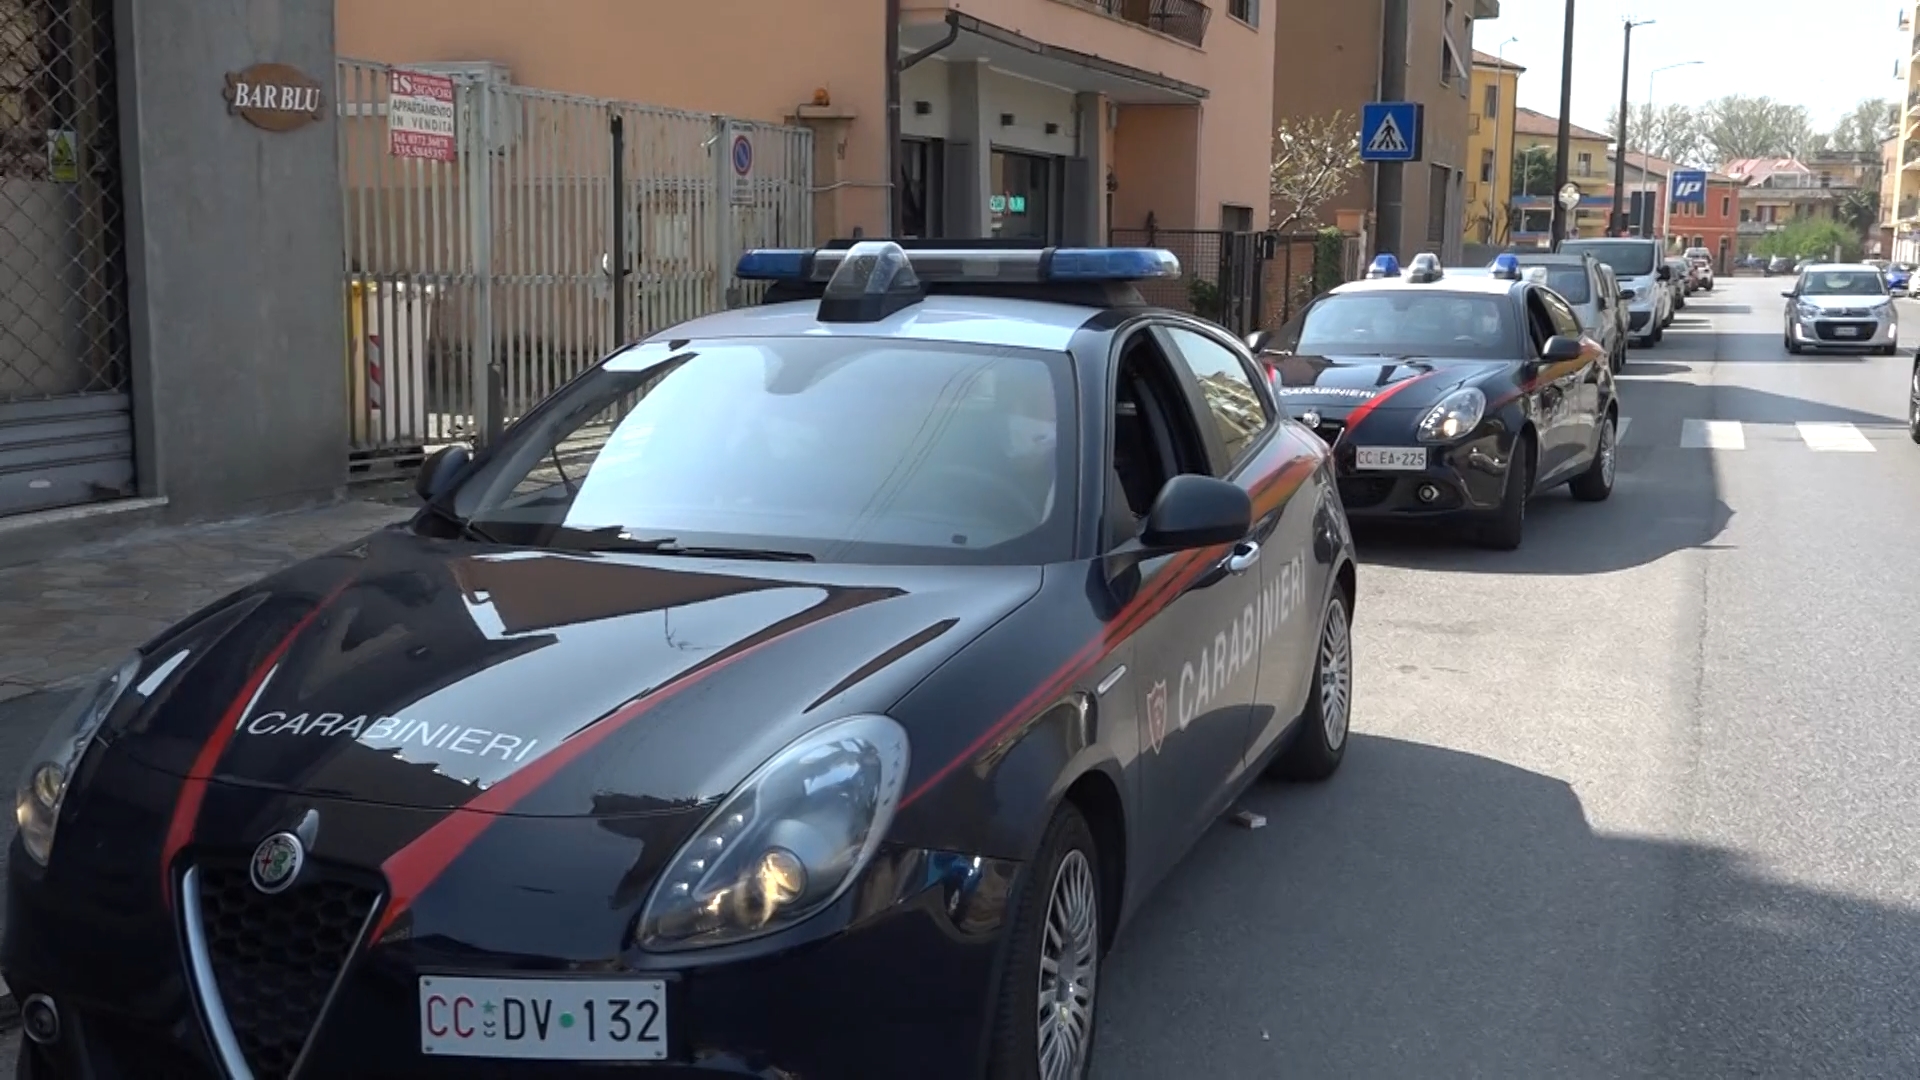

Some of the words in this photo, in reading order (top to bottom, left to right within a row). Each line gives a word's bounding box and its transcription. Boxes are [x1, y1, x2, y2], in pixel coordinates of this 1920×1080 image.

[235, 83, 277, 109] BAR
[280, 86, 320, 112] BLU
[392, 98, 453, 118] APPARTAMENTO
[392, 115, 404, 127] IN
[411, 117, 453, 132] VENDITA
[1675, 181, 1702, 197] IP
[1279, 386, 1377, 399] CARABINIERI
[1357, 450, 1373, 464] CC
[1380, 451, 1396, 465] EA
[1402, 453, 1425, 466] 225
[1179, 551, 1306, 731] CARABINIERI
[247, 710, 539, 763] CARABINIERI
[426, 995, 475, 1038] CC
[503, 997, 552, 1041] DV
[583, 998, 660, 1042] 132
